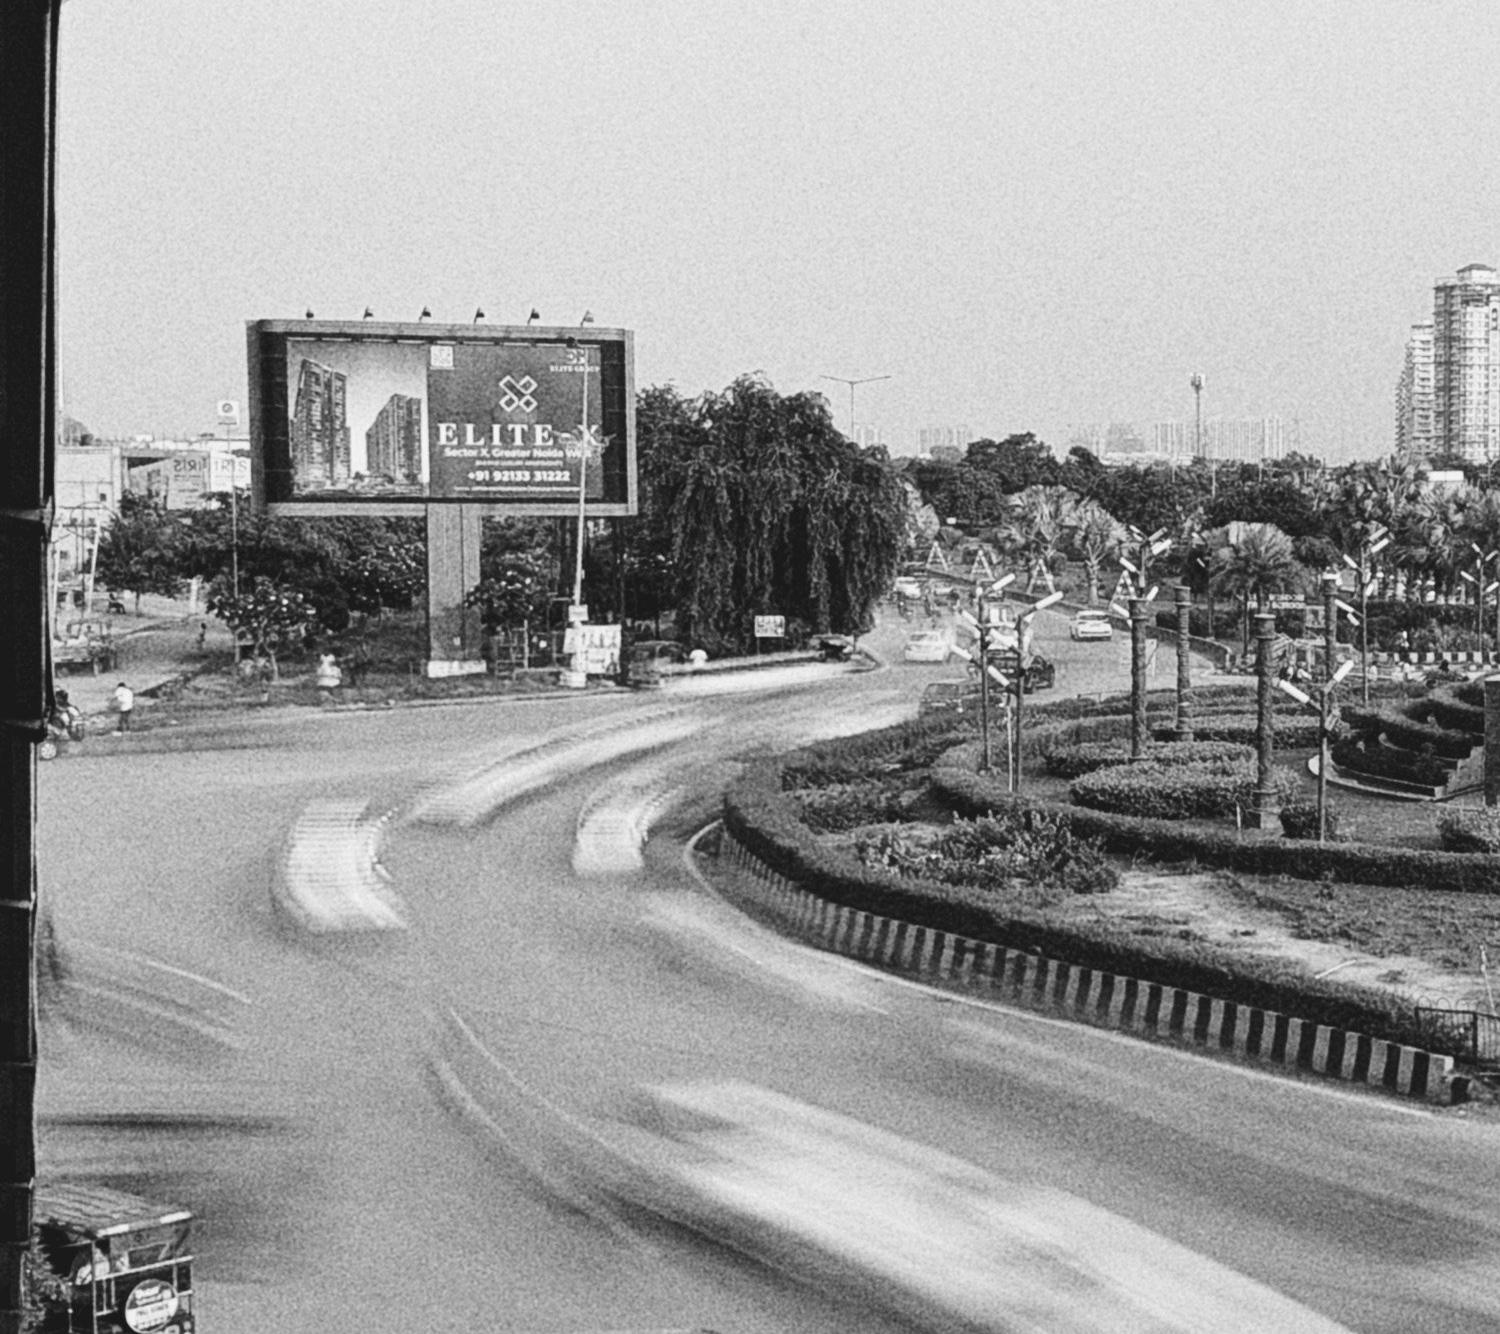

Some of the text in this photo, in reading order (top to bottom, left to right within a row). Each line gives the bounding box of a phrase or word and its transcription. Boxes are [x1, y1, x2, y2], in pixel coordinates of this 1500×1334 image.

[437, 423, 554, 446] ELITE
[444, 447, 478, 457] Sector
[492, 448, 531, 457] Greater
[533, 447, 564, 458] Noida
[468, 470, 571, 482] +91 92133 31222
